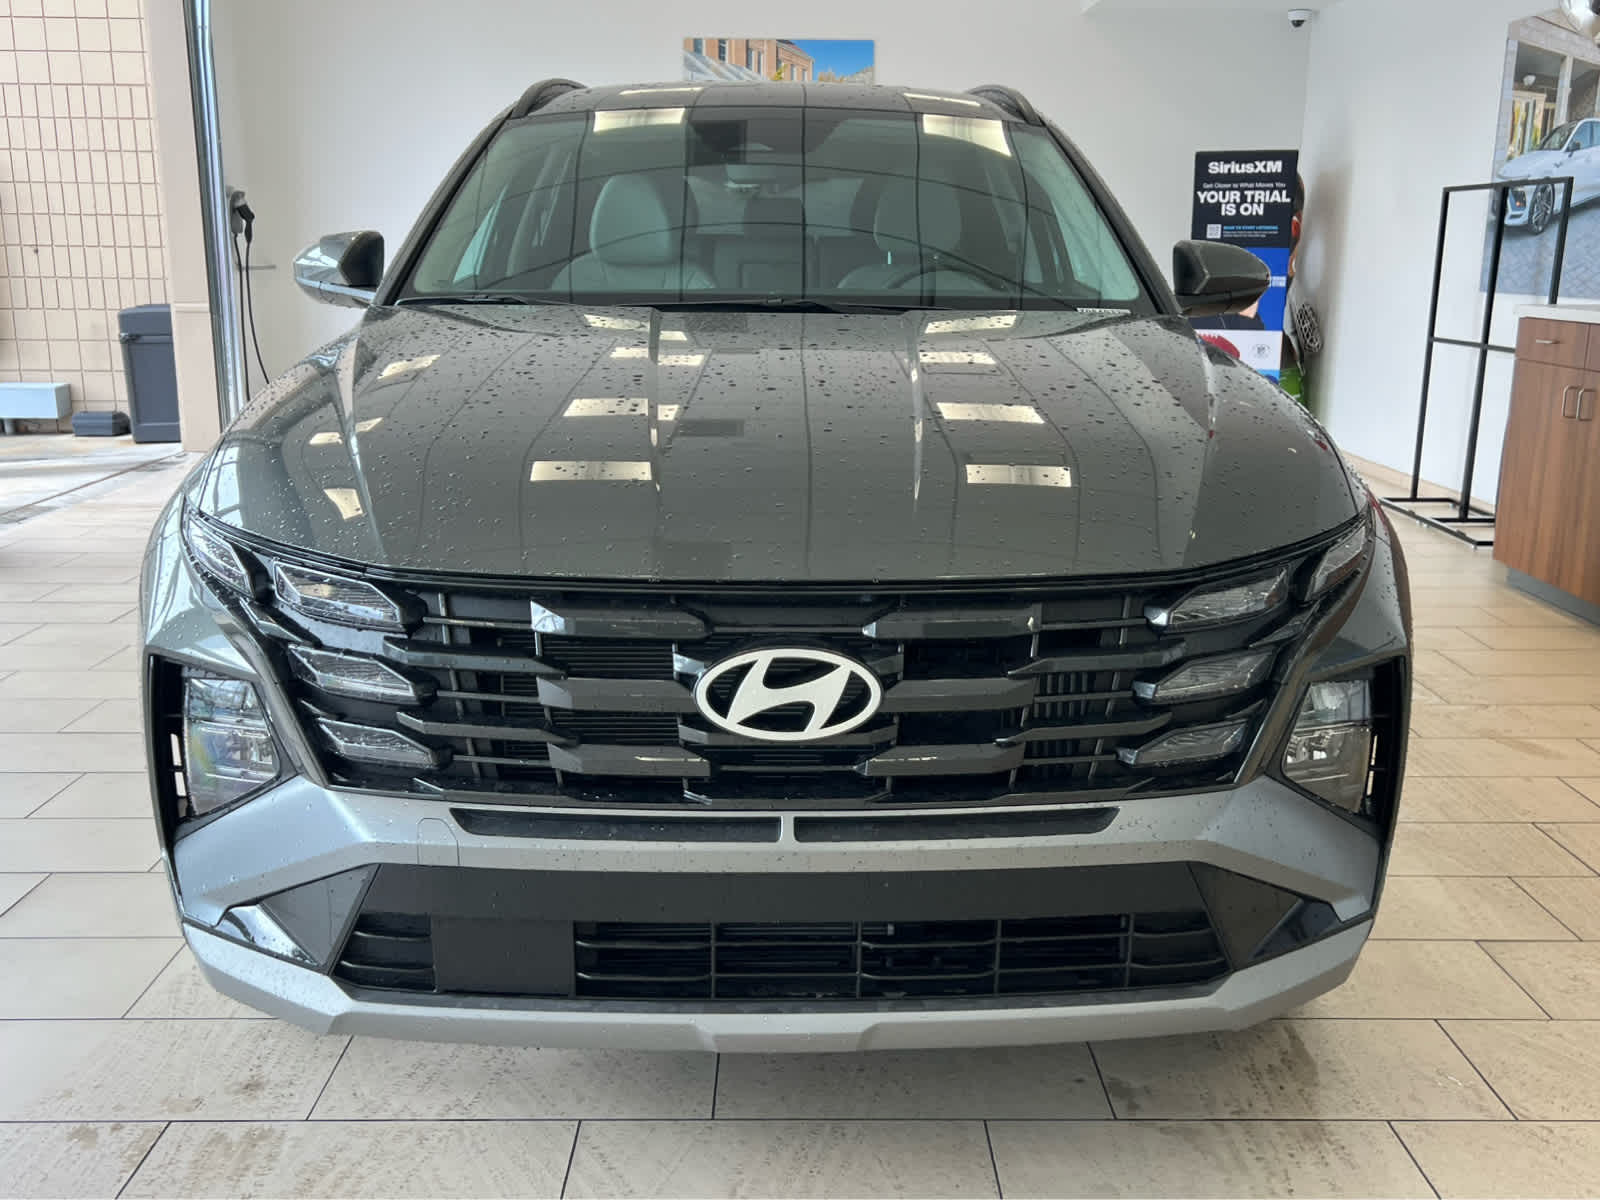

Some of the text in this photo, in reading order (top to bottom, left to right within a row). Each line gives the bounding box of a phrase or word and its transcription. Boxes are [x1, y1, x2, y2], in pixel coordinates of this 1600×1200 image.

[1208, 161, 1282, 173] SiriusXM
[1197, 190, 1291, 203] YOUR TRIAL
[1221, 203, 1264, 216] IS ON
